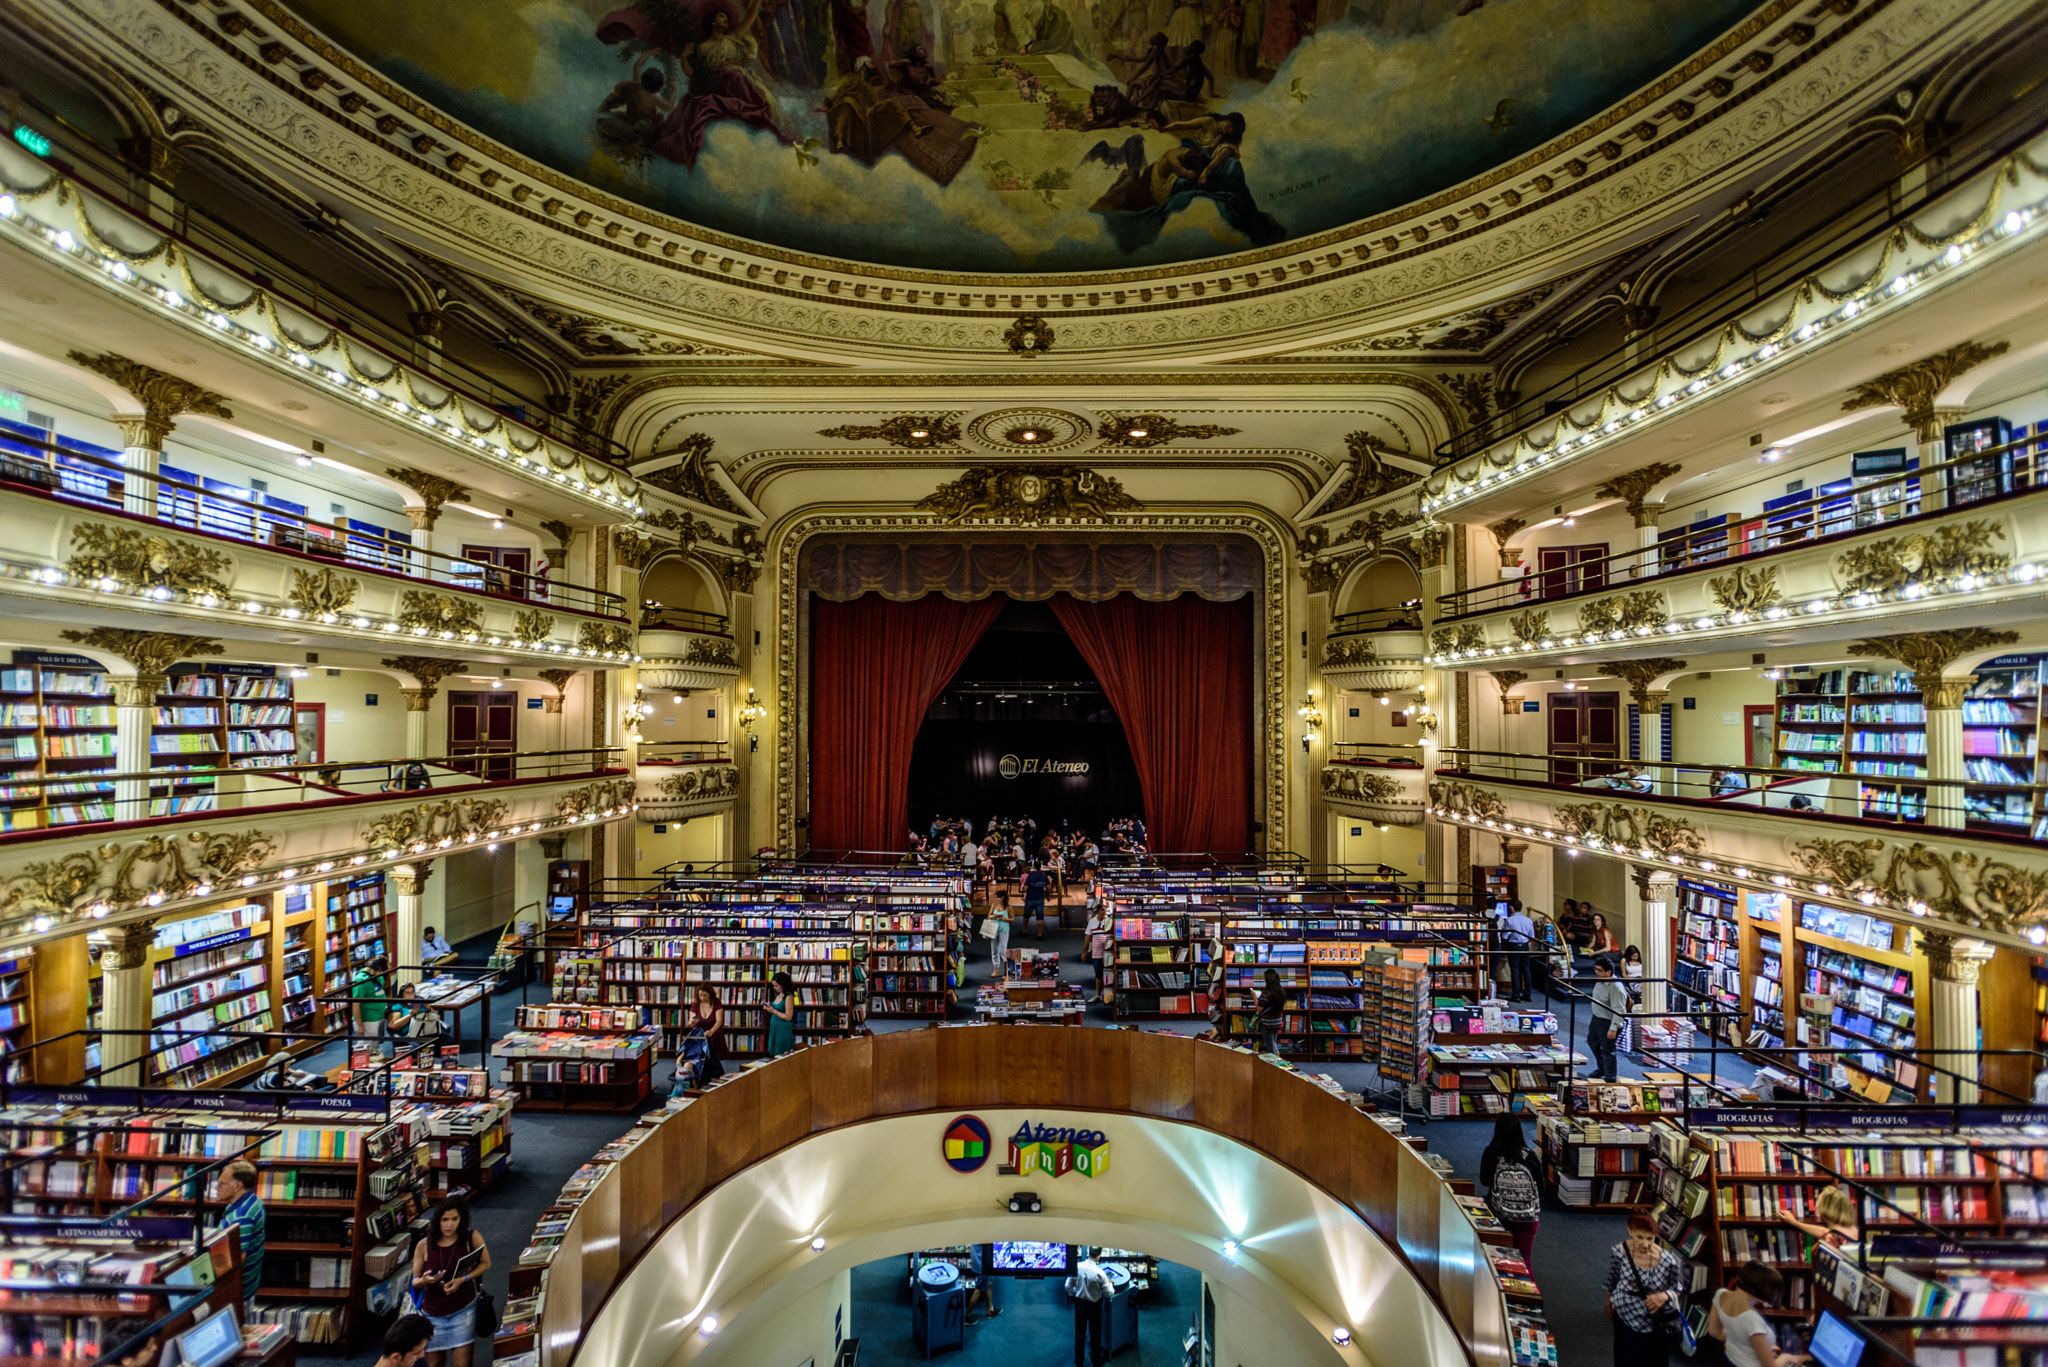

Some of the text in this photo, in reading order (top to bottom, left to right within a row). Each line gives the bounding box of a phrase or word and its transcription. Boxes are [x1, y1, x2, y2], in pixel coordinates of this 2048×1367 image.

[1021, 759, 1090, 773] El Ateneo
[188, 940, 210, 950] NOVELA
[58, 1094, 88, 1102] POESIA
[193, 1098, 225, 1107] POESIA
[320, 1098, 352, 1107] POESIA
[1717, 1114, 1774, 1123] BIOGRAFIAS
[1851, 1116, 1909, 1125] BIOGRAFIAS
[1013, 1119, 1106, 1147] Ateneo
[1009, 1145, 1108, 1171] Junior
[57, 1228, 143, 1238] LATINOAMERICANA
